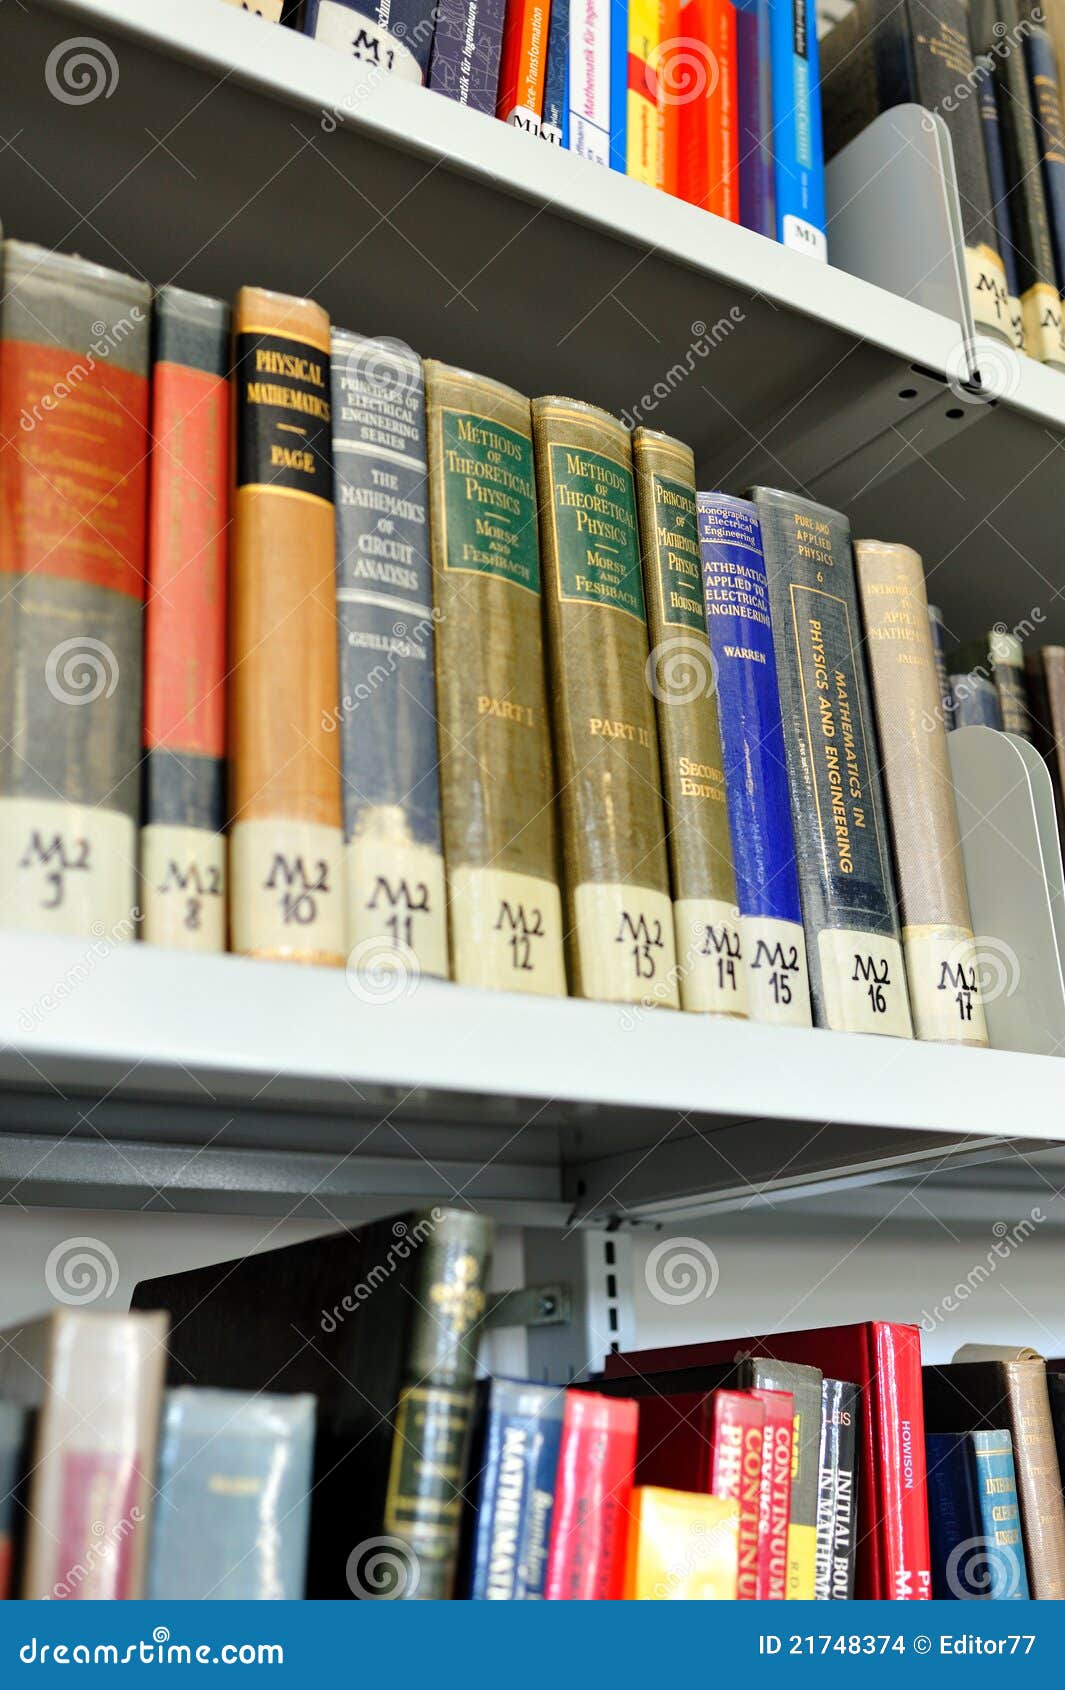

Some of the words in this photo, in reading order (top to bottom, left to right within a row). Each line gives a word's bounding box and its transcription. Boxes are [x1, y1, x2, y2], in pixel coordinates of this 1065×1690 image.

[256, 349, 325, 388] PHYSICAL
[247, 382, 330, 422] MATHEMATICS
[347, 393, 416, 424] ELECTRICAL
[341, 407, 419, 441] ENGINEERING
[361, 426, 405, 450] SERIES
[457, 419, 522, 461] METHODS
[271, 445, 316, 474] PAGE
[487, 452, 502, 464] OF
[566, 453, 627, 493] METHODS
[371, 469, 399, 491] THE
[446, 450, 534, 499] THEORETICAL
[595, 483, 608, 496] OF
[340, 484, 425, 525] MATHEMATICS
[465, 477, 520, 516] PHYSICS
[556, 484, 636, 530] THEORETICAL
[475, 518, 519, 548] MORSE
[575, 510, 628, 546] PHYSICS
[705, 525, 755, 547] Engineering
[708, 515, 752, 534] Electrical
[794, 514, 814, 530] PURE
[815, 521, 830, 535] AND
[796, 530, 832, 551] APPLIED
[358, 534, 413, 565] CIRCUIT
[462, 543, 530, 580] FESHBACH
[587, 550, 627, 576] MORSE
[668, 552, 699, 579] PHYSICS
[798, 544, 834, 567] PHYSICS
[353, 556, 419, 591] ANALYSIS
[600, 572, 619, 585] AND
[706, 576, 752, 592] APPLIED
[754, 583, 765, 597] TO
[816, 571, 824, 583] 6
[575, 574, 638, 608] FESHBACH
[706, 590, 768, 612] ELECTRICAL
[724, 646, 766, 665] WARREN
[809, 619, 829, 691] PHYSICS
[478, 696, 524, 723] PART
[818, 696, 836, 738] AND
[589, 718, 635, 741] PART
[835, 670, 862, 799] MATHEMATICS
[853, 805, 866, 829] IN
[825, 745, 854, 874] ENGINEERING
[264, 854, 330, 893] M2
[281, 893, 317, 926] 10
[366, 876, 430, 912] M2
[494, 900, 545, 937] M2
[615, 911, 664, 948] M2
[510, 934, 534, 970] 12
[702, 925, 742, 960] M2
[750, 940, 800, 972] M2
[633, 944, 656, 979] 13
[718, 958, 737, 990] 14
[852, 954, 891, 985] M2
[937, 961, 978, 993] M2
[769, 972, 792, 1004] 15
[868, 984, 887, 1013] 16
[955, 992, 973, 1020] 17
[901, 1420, 914, 1490] HOWISON
[821, 1467, 834, 1491] IN
[769, 1427, 791, 1599] CONTINUUM
[834, 1469, 852, 1550] INITIAL
